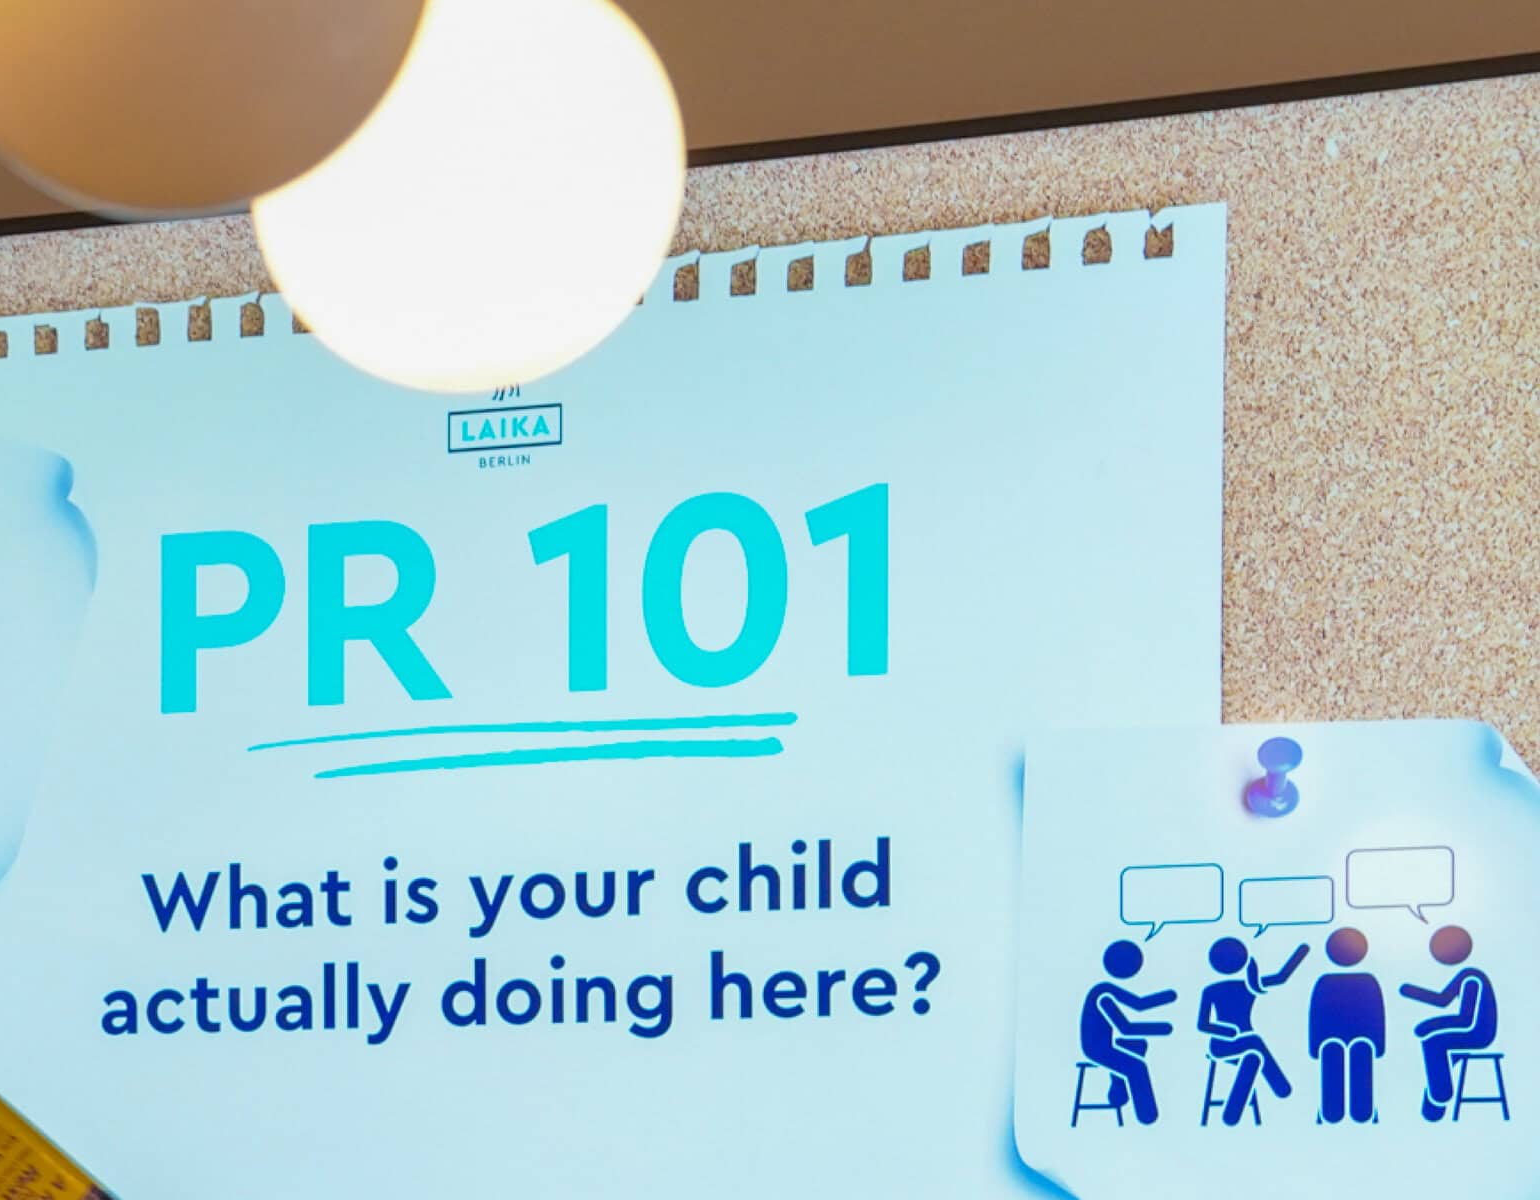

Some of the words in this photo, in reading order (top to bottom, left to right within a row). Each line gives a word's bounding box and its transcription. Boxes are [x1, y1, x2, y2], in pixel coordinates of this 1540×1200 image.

[461, 414, 551, 442] LAIKA
[478, 454, 532, 469] BERLIN
[160, 520, 454, 716] PR
[527, 482, 890, 692] 101
[141, 863, 352, 932] What
[384, 856, 438, 924] is
[469, 869, 654, 938] your
[686, 836, 890, 913] child
[102, 961, 411, 1045] actually
[441, 955, 672, 1038] doing
[710, 950, 940, 1020] here?
